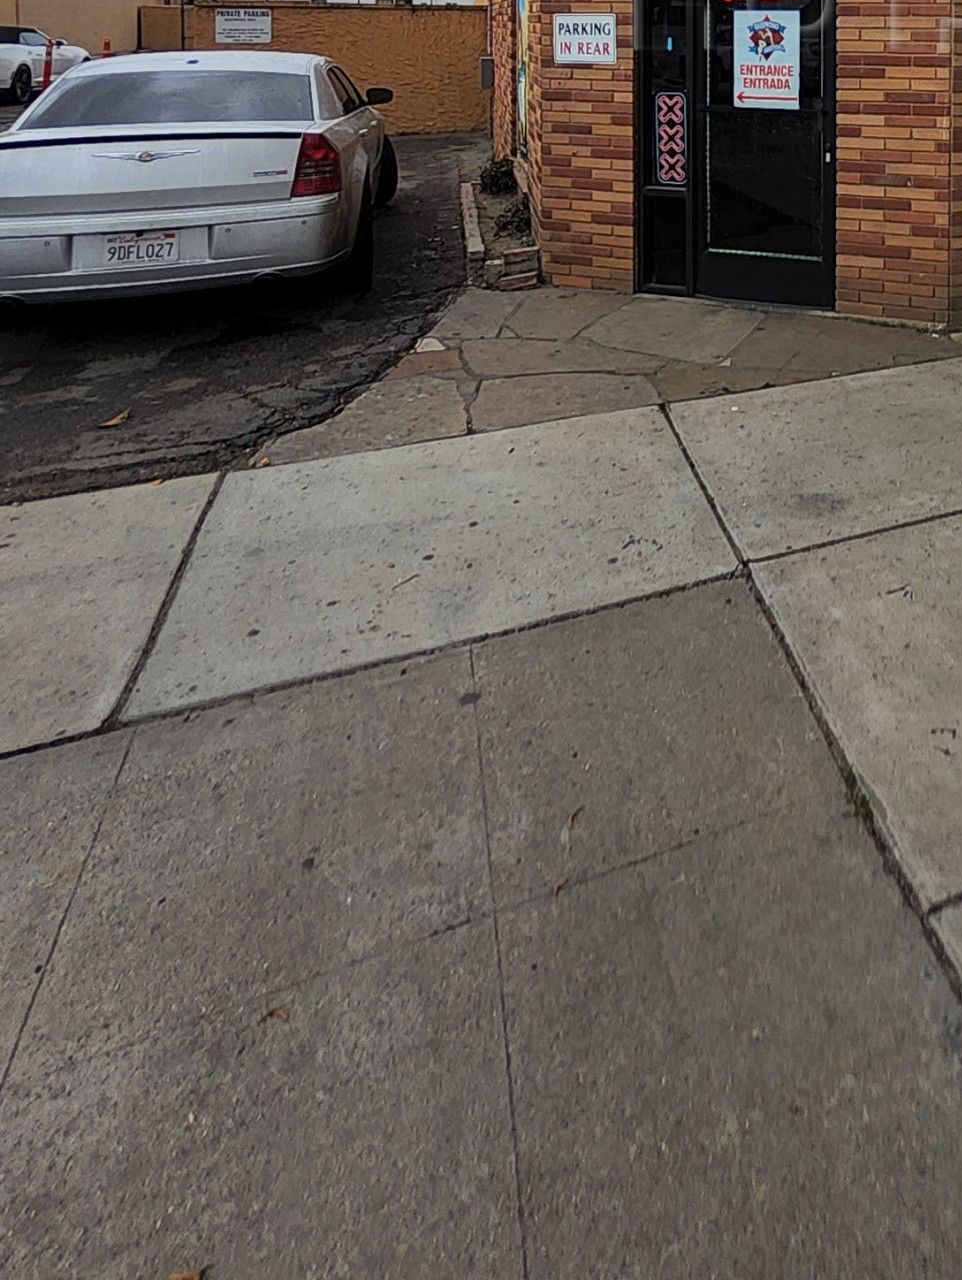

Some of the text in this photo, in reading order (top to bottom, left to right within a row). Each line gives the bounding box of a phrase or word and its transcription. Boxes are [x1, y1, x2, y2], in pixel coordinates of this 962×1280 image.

[558, 22, 611, 36] PARKING
[560, 42, 610, 55] IN REAR
[740, 64, 794, 78] ENTRANCE
[743, 77, 791, 90] ENTRADA
[658, 94, 685, 182] XXX
[106, 242, 174, 262] 9DFL027
